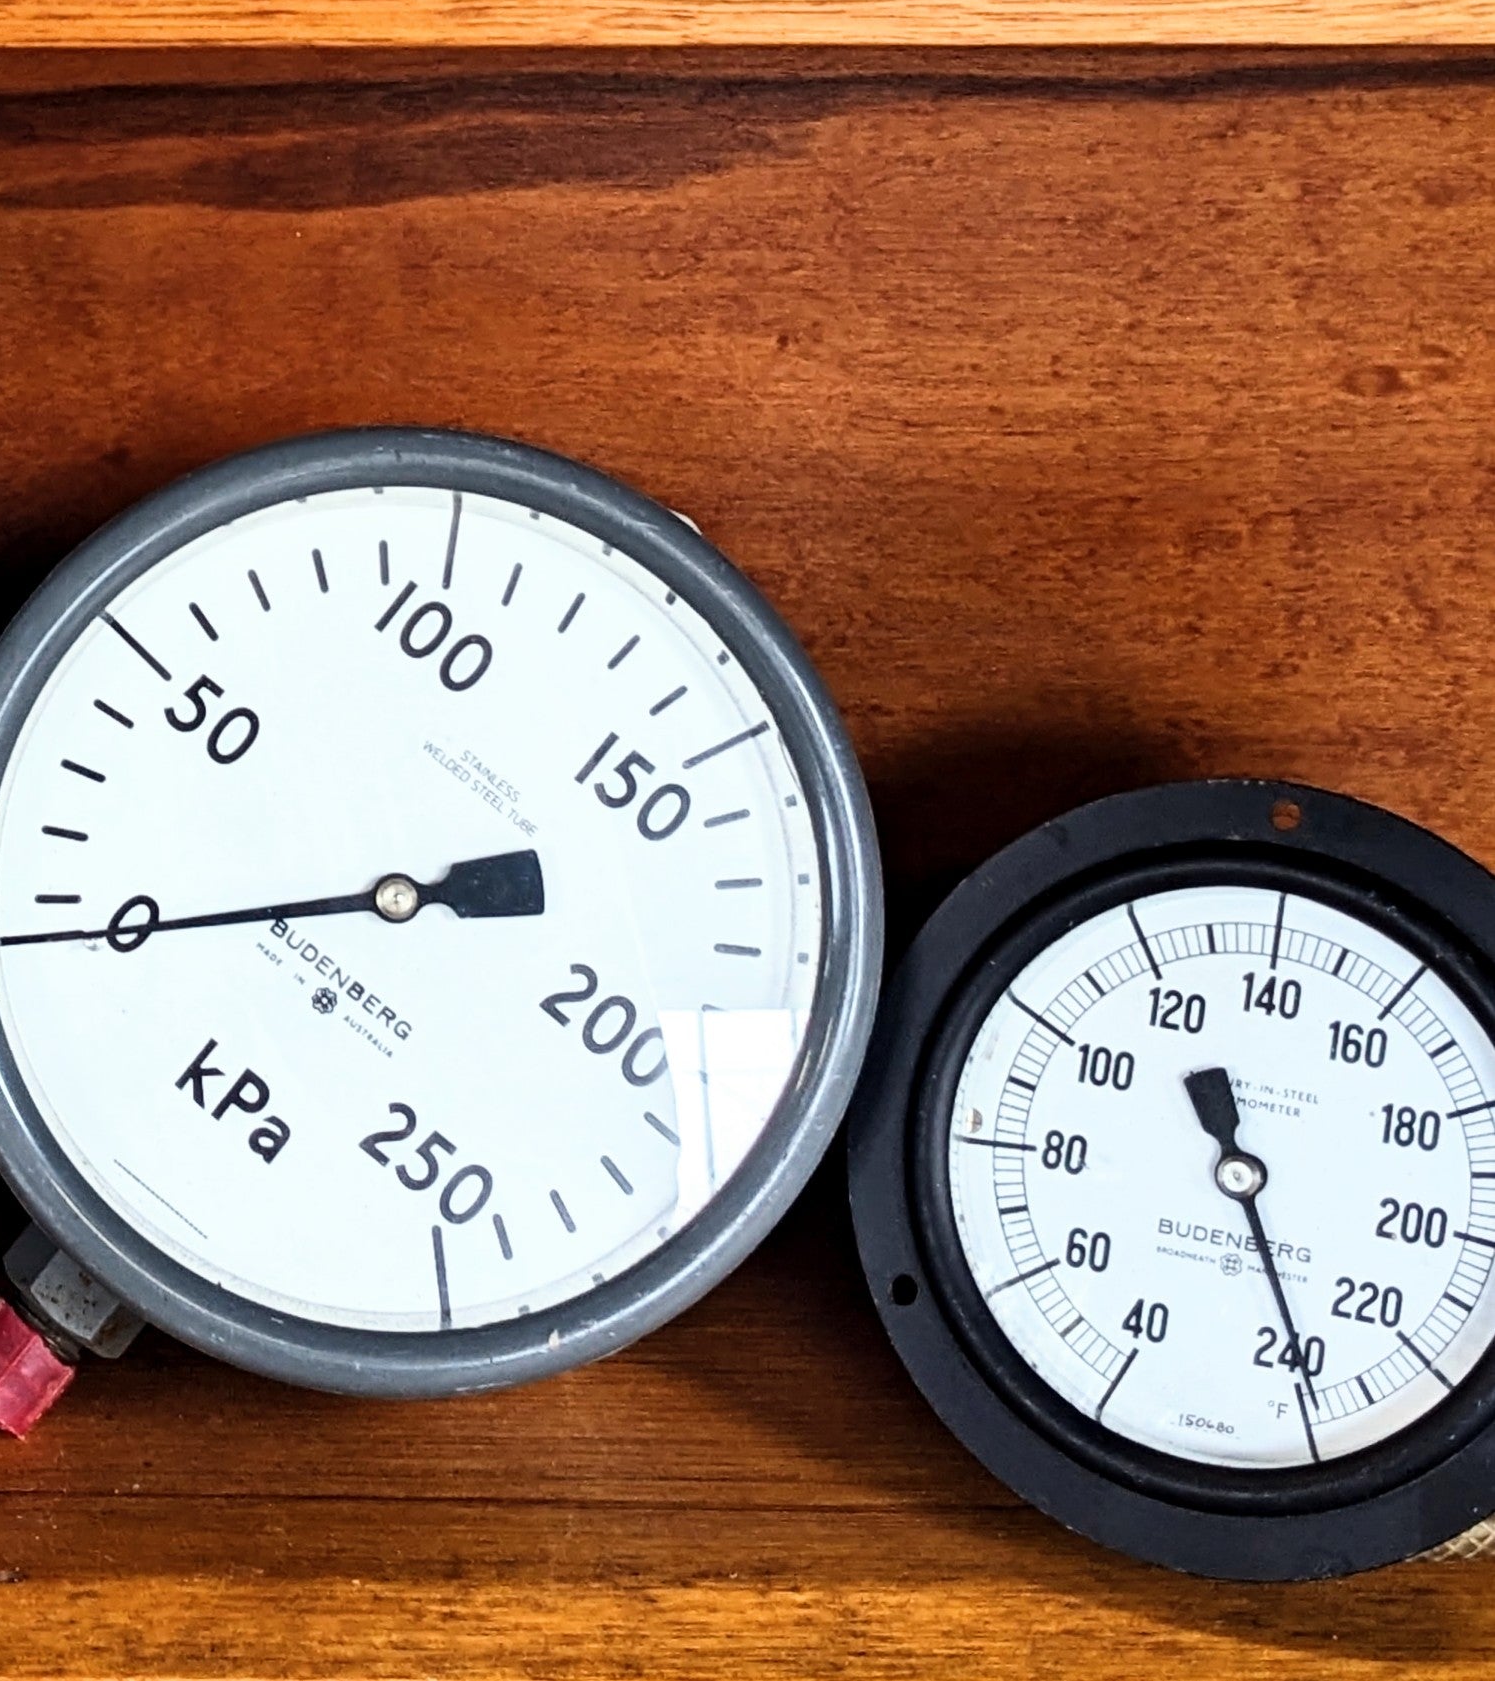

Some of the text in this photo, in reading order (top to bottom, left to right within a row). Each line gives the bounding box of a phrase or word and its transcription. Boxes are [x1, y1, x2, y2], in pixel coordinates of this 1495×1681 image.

[374, 580, 494, 692] 100
[164, 674, 261, 766] 50
[423, 740, 539, 837] WELDED STEEL TUBE
[460, 749, 521, 803] STAINLESS
[573, 732, 691, 841] 150
[106, 894, 160, 952] 0
[256, 942, 283, 966] MADE
[343, 1015, 394, 1058] AUSTRALIA
[269, 918, 413, 1041] BUDENBERG
[1242, 970, 1302, 1021] 140
[539, 963, 669, 1087] 200
[1147, 986, 1206, 1034] 120
[1076, 1043, 1135, 1092] 100
[1328, 1020, 1388, 1069] 160
[174, 1039, 292, 1164] kPa
[1381, 1103, 1441, 1151] 180
[359, 1101, 494, 1226] 250
[1040, 1130, 1088, 1175] 80
[1375, 1197, 1448, 1249] 200
[1064, 1228, 1111, 1273] 60
[1121, 1299, 1170, 1344] 40
[1331, 1276, 1403, 1328] 220
[1253, 1326, 1325, 1377] 240
